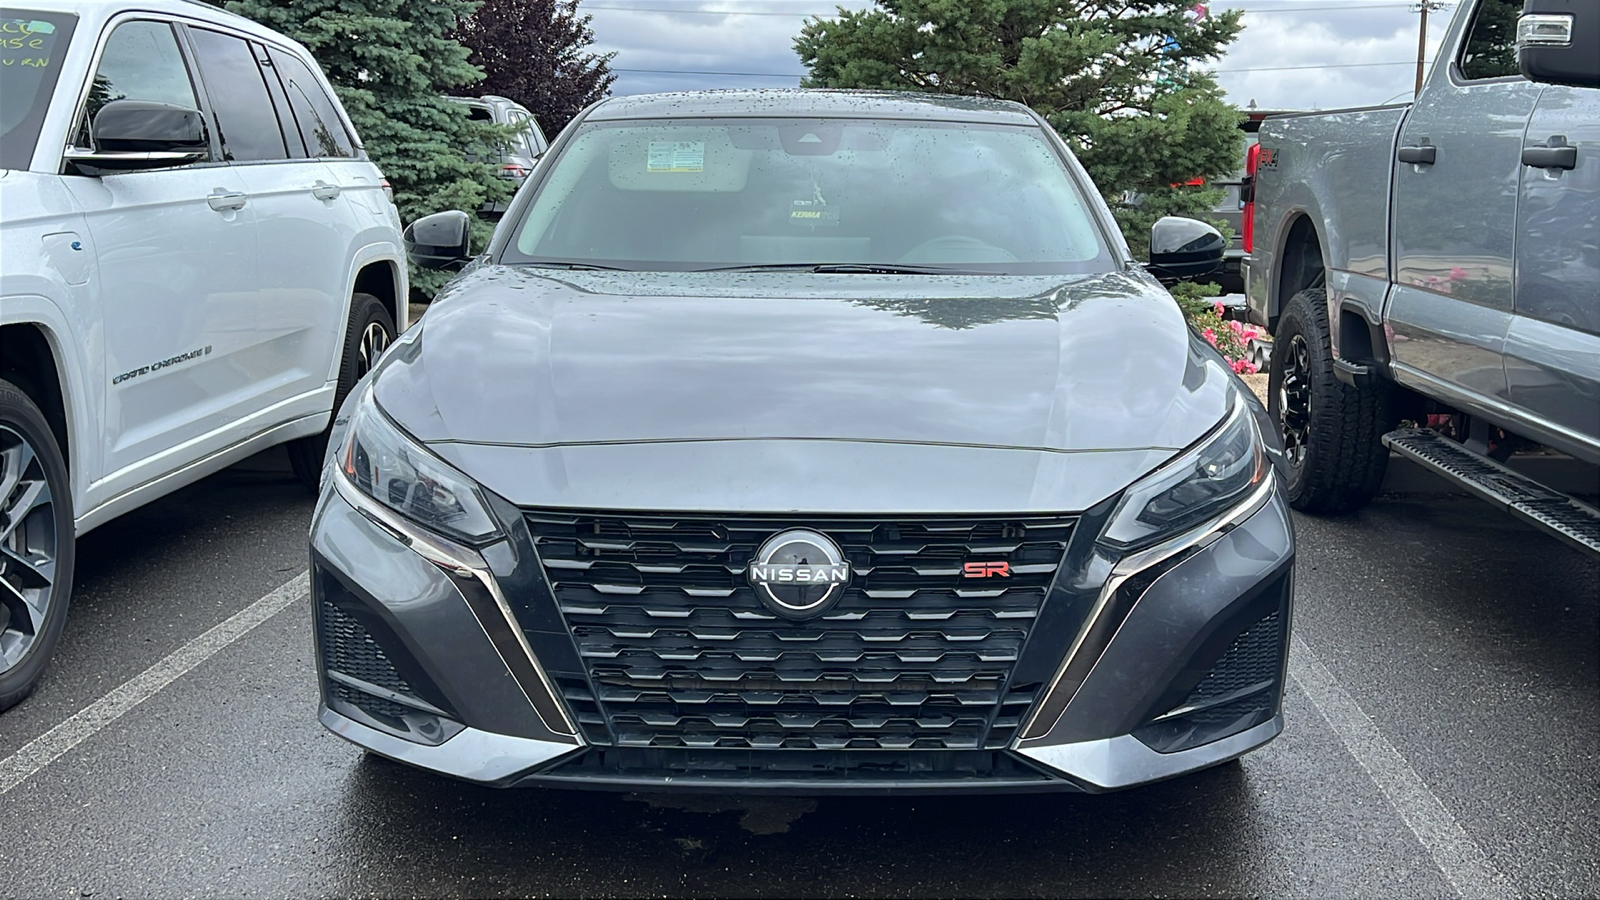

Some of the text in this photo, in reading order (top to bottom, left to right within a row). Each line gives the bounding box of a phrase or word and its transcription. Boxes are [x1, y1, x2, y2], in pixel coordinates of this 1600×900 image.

[112, 348, 203, 385] GRAND CHEROKEE
[752, 567, 847, 581] NISSAN
[964, 561, 1010, 578] SR
